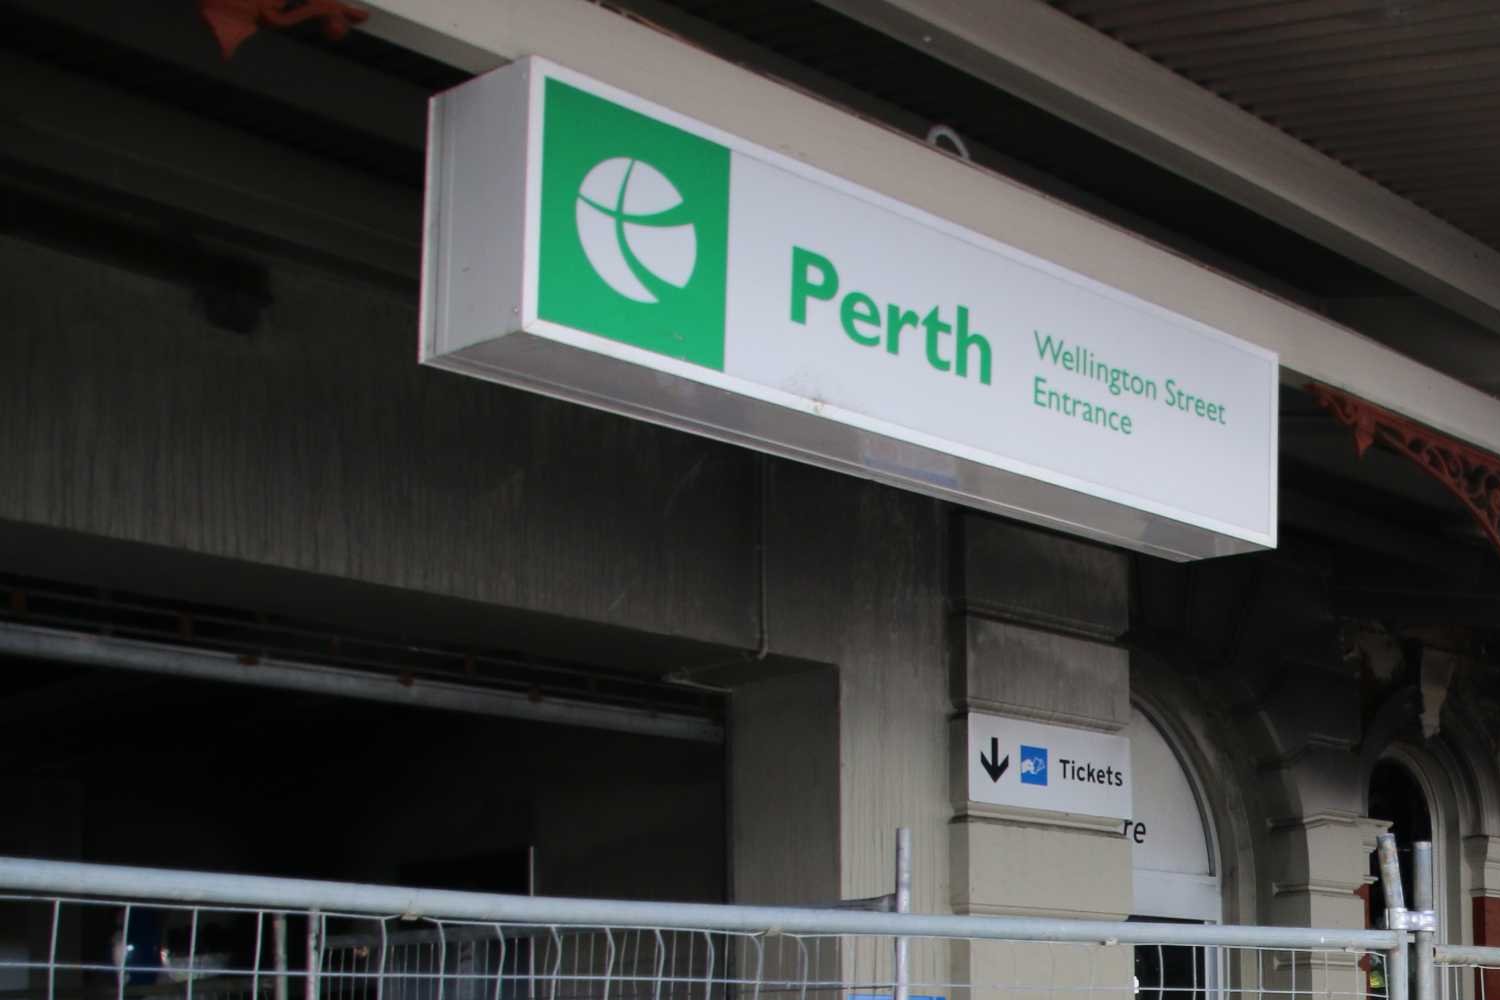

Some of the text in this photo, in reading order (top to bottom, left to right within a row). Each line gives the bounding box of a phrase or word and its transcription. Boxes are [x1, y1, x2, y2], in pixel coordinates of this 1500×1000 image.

[790, 245, 992, 386] Perth
[1033, 329, 1227, 425] Wellington Street
[1033, 375, 1133, 435] Entrance
[1058, 759, 1124, 787] Tickets
